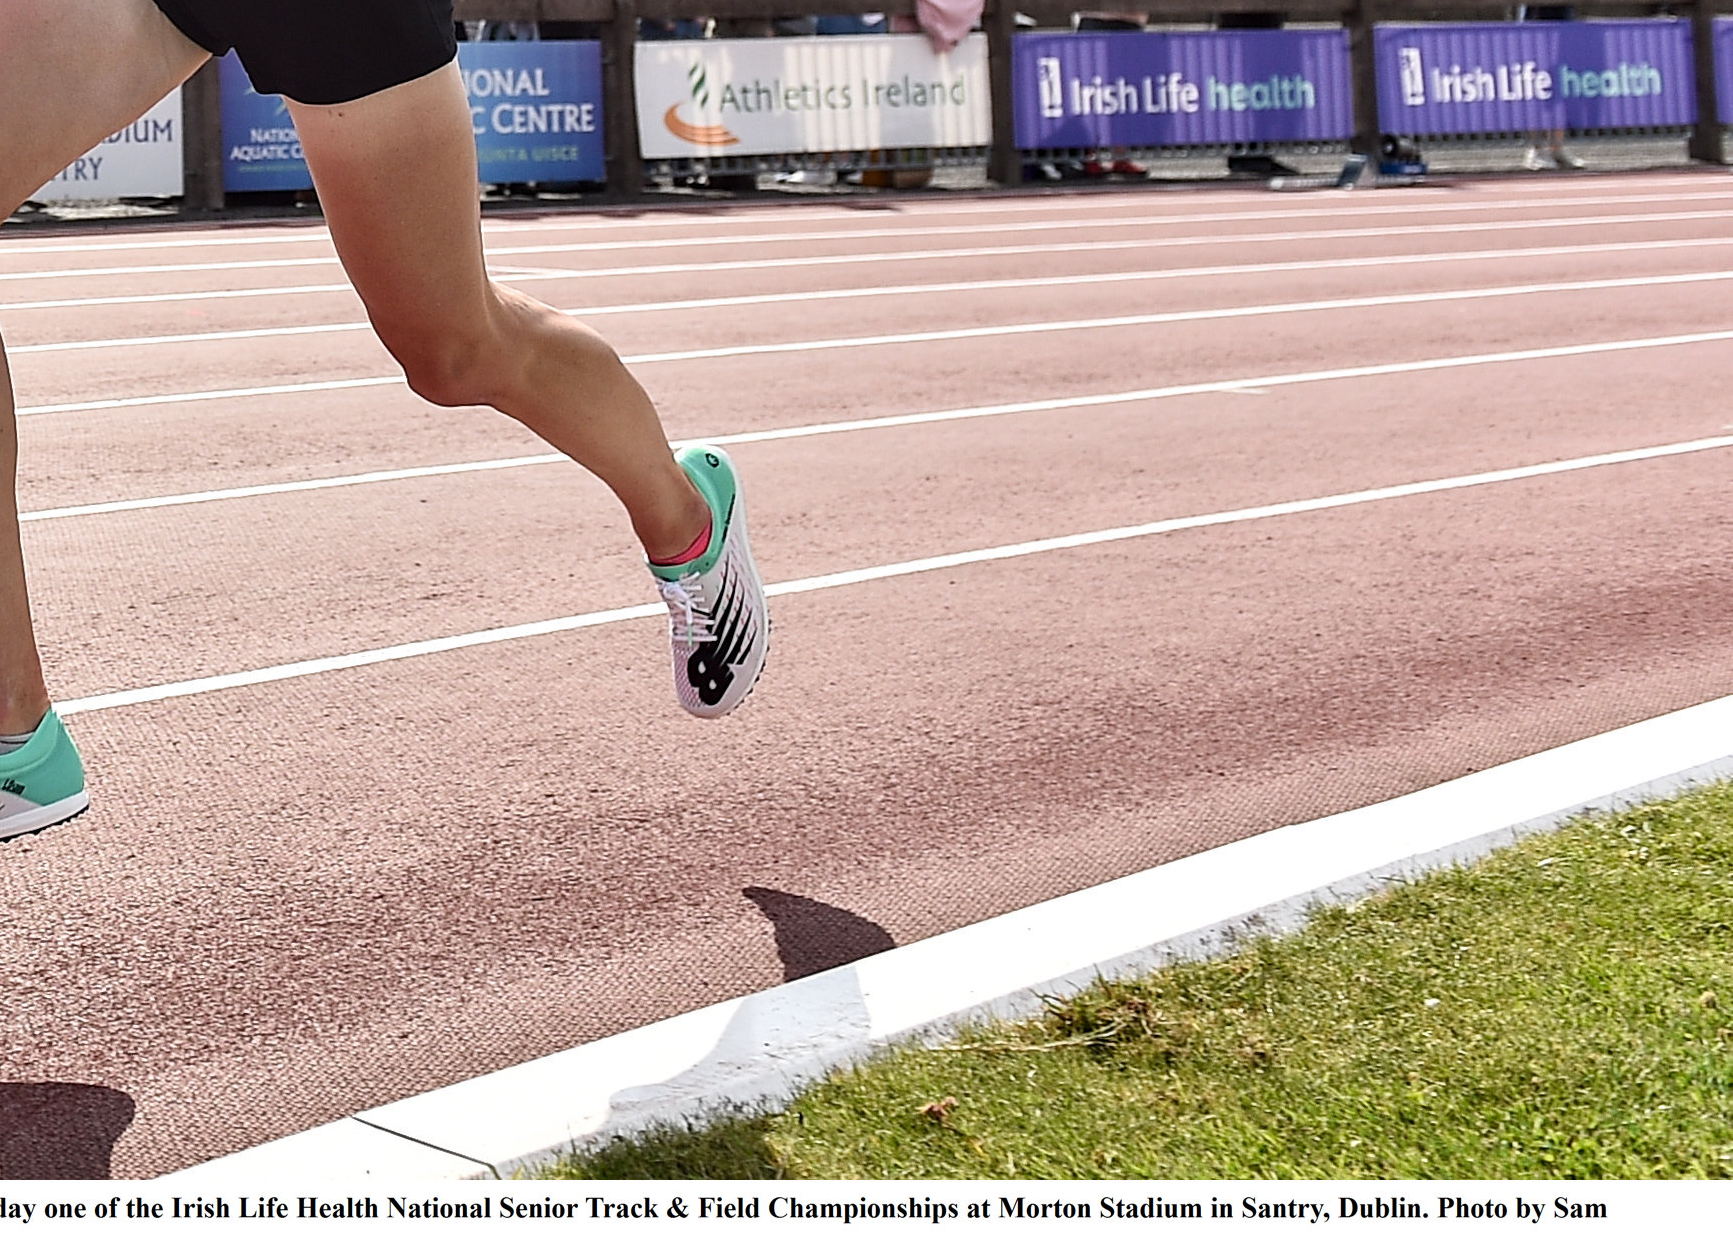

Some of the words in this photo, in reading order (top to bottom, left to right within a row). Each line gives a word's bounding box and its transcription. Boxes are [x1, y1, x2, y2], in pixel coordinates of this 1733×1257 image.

[464, 68, 550, 98] IONAL
[720, 79, 852, 113] Athletics
[862, 73, 966, 108] Ireland
[1071, 75, 1139, 115] Irish
[1142, 72, 1199, 114] Life
[1208, 74, 1315, 111] health
[1432, 64, 1495, 103] Irish
[1496, 61, 1552, 101] Life
[1561, 61, 1663, 97] health
[491, 103, 595, 134] CENTRE
